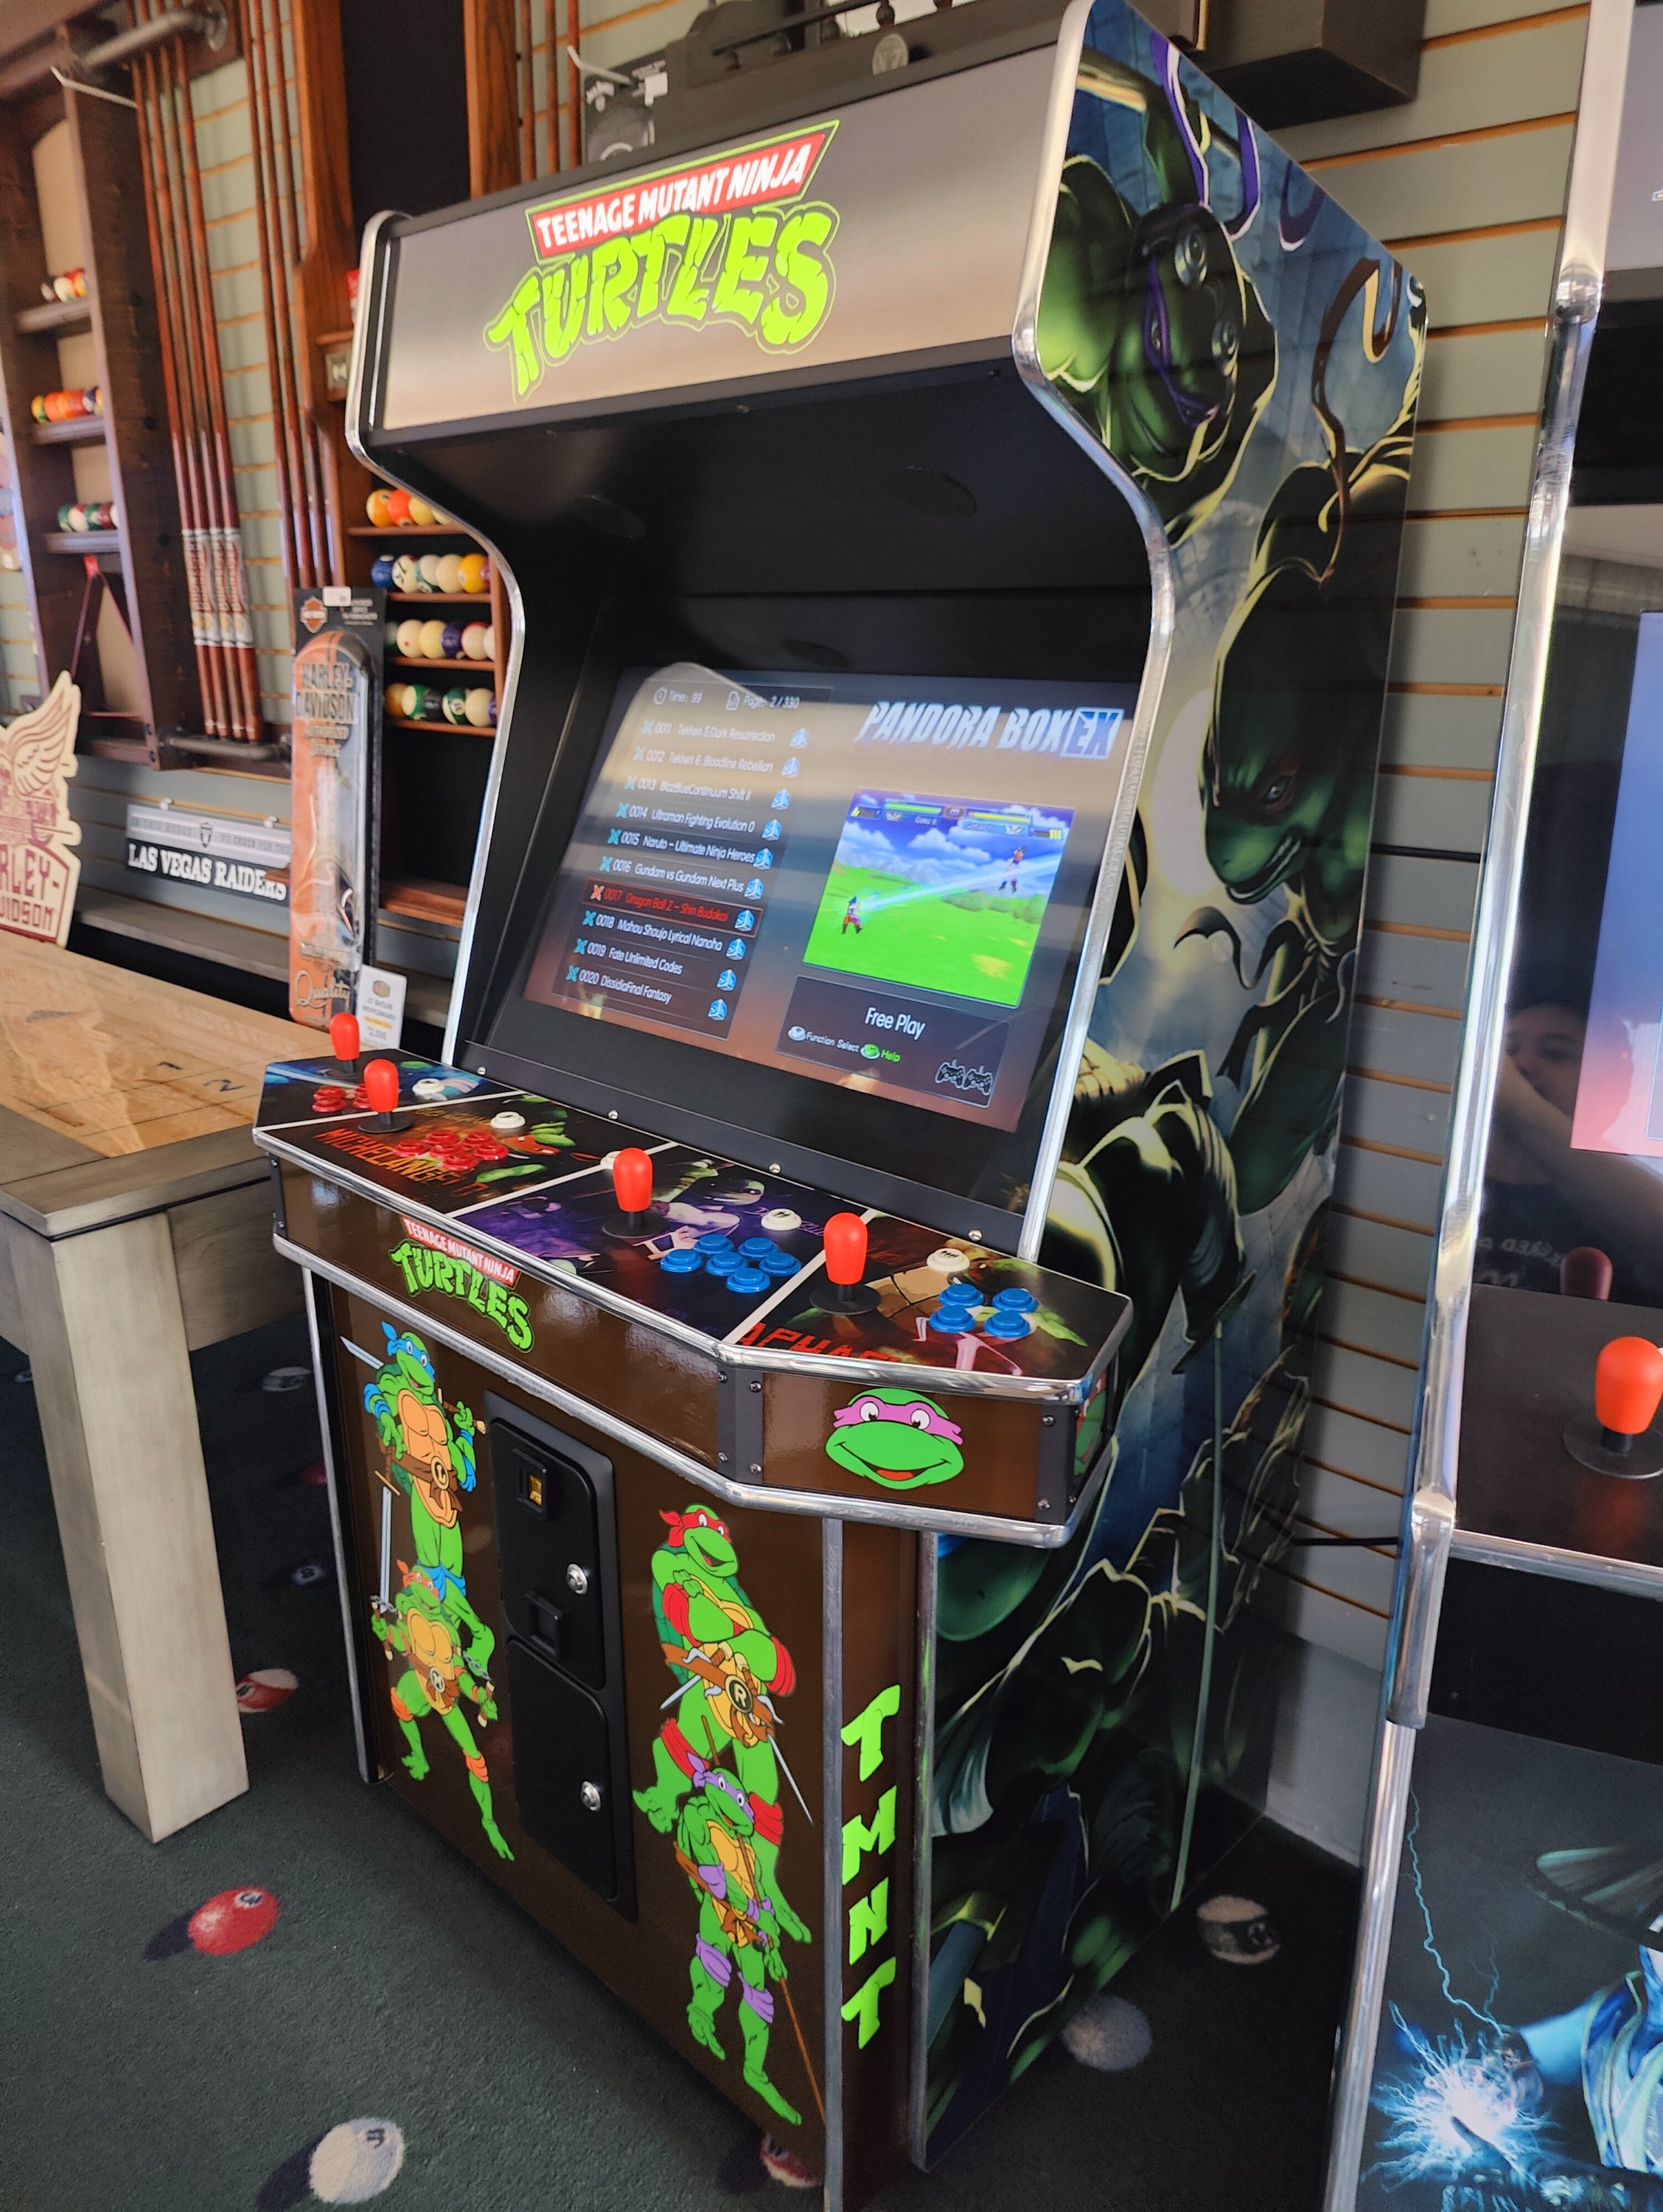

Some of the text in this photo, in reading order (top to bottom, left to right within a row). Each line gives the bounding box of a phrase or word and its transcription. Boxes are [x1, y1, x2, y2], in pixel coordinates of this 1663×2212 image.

[535, 143, 812, 248] TEENAGE MUTANT NINJA
[487, 212, 832, 395] TURTLES
[677, 724, 702, 737] Tekken
[855, 700, 1001, 751] PANDORA
[646, 749, 665, 763] 0012
[669, 751, 694, 765] Tekken
[702, 755, 737, 769] Bloodline
[738, 758, 773, 773] Rebellion
[638, 778, 656, 791] 0013
[629, 805, 648, 819] 0014
[651, 808, 685, 823] Ultraman
[685, 813, 714, 830] Fighting
[714, 815, 747, 832] Evolution
[128, 843, 158, 872] LAS
[159, 849, 213, 884] VEGAS
[621, 830, 641, 846] 0015
[643, 835, 668, 849] Naruto
[674, 840, 706, 855] Ultimate
[705, 845, 726, 860] Ninja
[726, 848, 756, 863] Heroes
[613, 858, 745, 892] 0016 Gundam vs Gundam Next Plus
[604, 888, 623, 901] 0017
[625, 892, 652, 908] Dragon
[652, 897, 667, 910] Ball
[666, 900, 674, 911] Z
[680, 902, 697, 914] Shin
[697, 905, 729, 922] Budokai
[596, 914, 723, 951] 0018 Mahou Shoujo Lyrical Nanoha
[587, 942, 683, 975] 0019 Fate Unlimited Codes
[579, 969, 600, 985] 0020
[643, 987, 673, 1005] Fantasy
[865, 1006, 926, 1040] Free Play
[806, 1031, 860, 1053] Function Select
[881, 1049, 901, 1062] Help
[405, 1218, 515, 1283] TEENAGE MUTANT NINJA
[391, 1242, 533, 1349] TURTLES
[733, 1683, 747, 1708] R
[841, 1684, 900, 2049] TMNT
